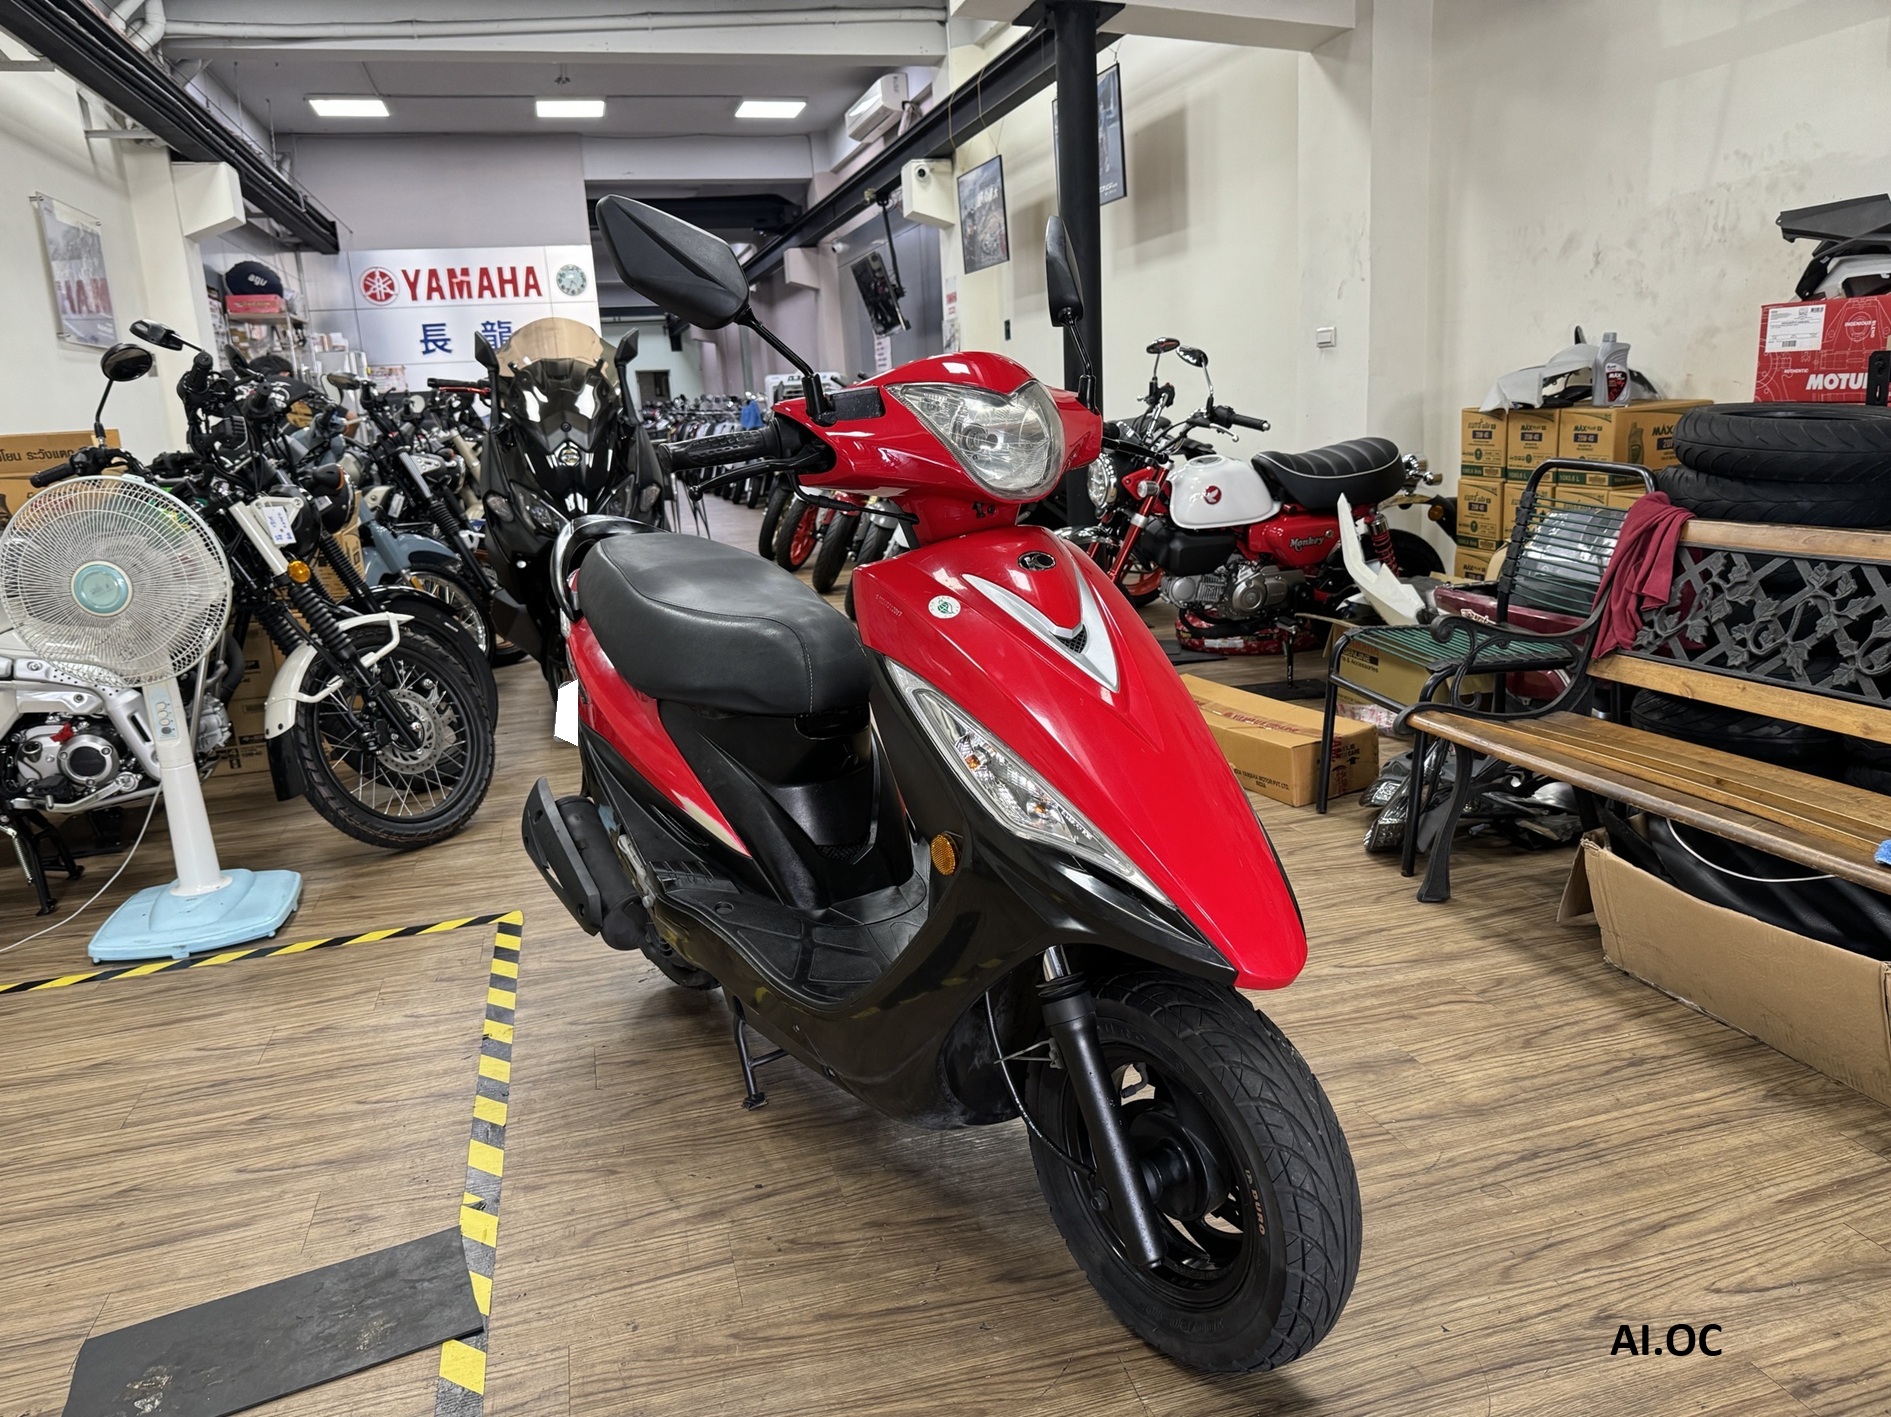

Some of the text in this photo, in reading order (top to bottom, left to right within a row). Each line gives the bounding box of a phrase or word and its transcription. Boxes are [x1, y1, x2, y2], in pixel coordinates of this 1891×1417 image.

[401, 265, 543, 301] YAMAHA
[1290, 536, 1324, 552] Monkey
[1351, 658, 1379, 674] Accessories
[1258, 775, 1273, 785] MOTOR
[1250, 1187, 1266, 1237] DURO
